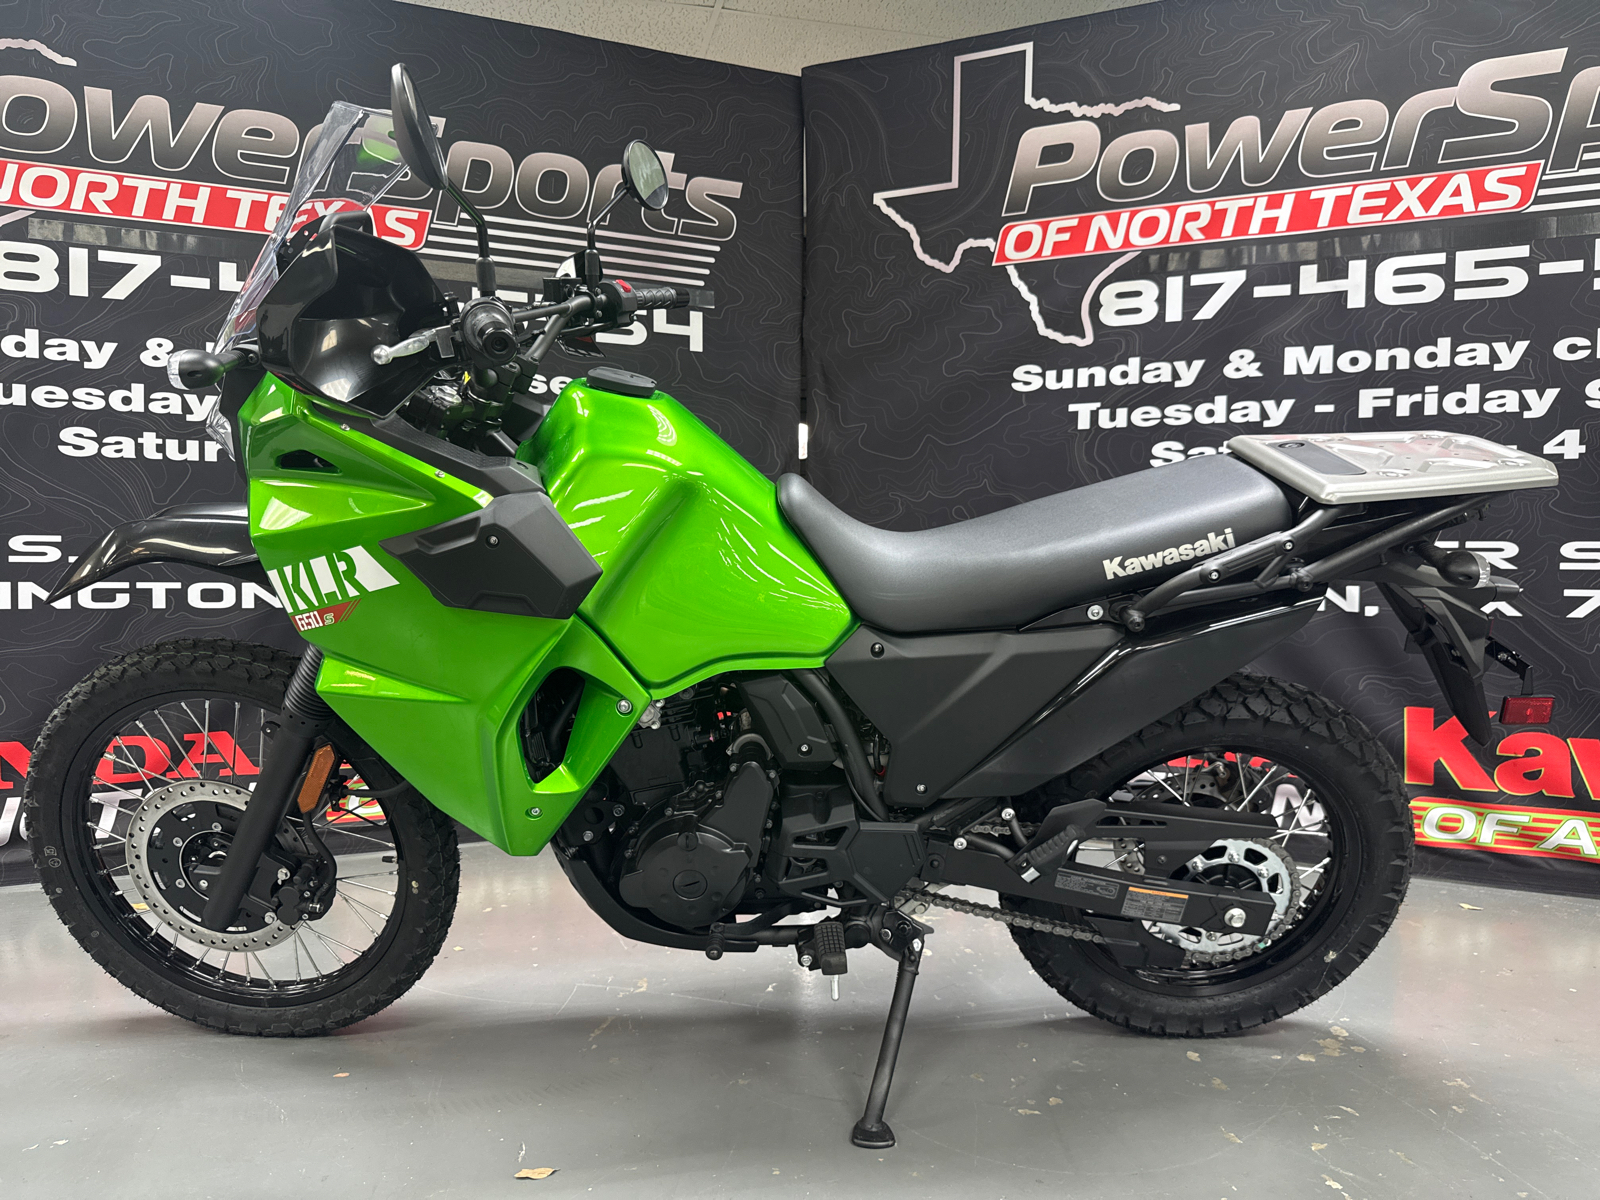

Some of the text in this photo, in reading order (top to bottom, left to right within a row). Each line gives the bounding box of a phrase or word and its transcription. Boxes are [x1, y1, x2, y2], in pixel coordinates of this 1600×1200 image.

[226, 190, 419, 246] TEXS
[1003, 166, 1528, 260] OF NORTH TEXAS
[1098, 237, 1600, 327] 817-465-
[0, 328, 175, 369] day &
[1011, 357, 1205, 392] Sunday
[1222, 348, 1262, 379] &
[1283, 336, 1530, 376] Monday
[1068, 395, 1296, 431] Tuesday
[1358, 383, 1561, 419] Friday
[268, 545, 372, 614] KLR
[1102, 528, 1235, 581] Kawasaki
[1422, 806, 1531, 844] OF
